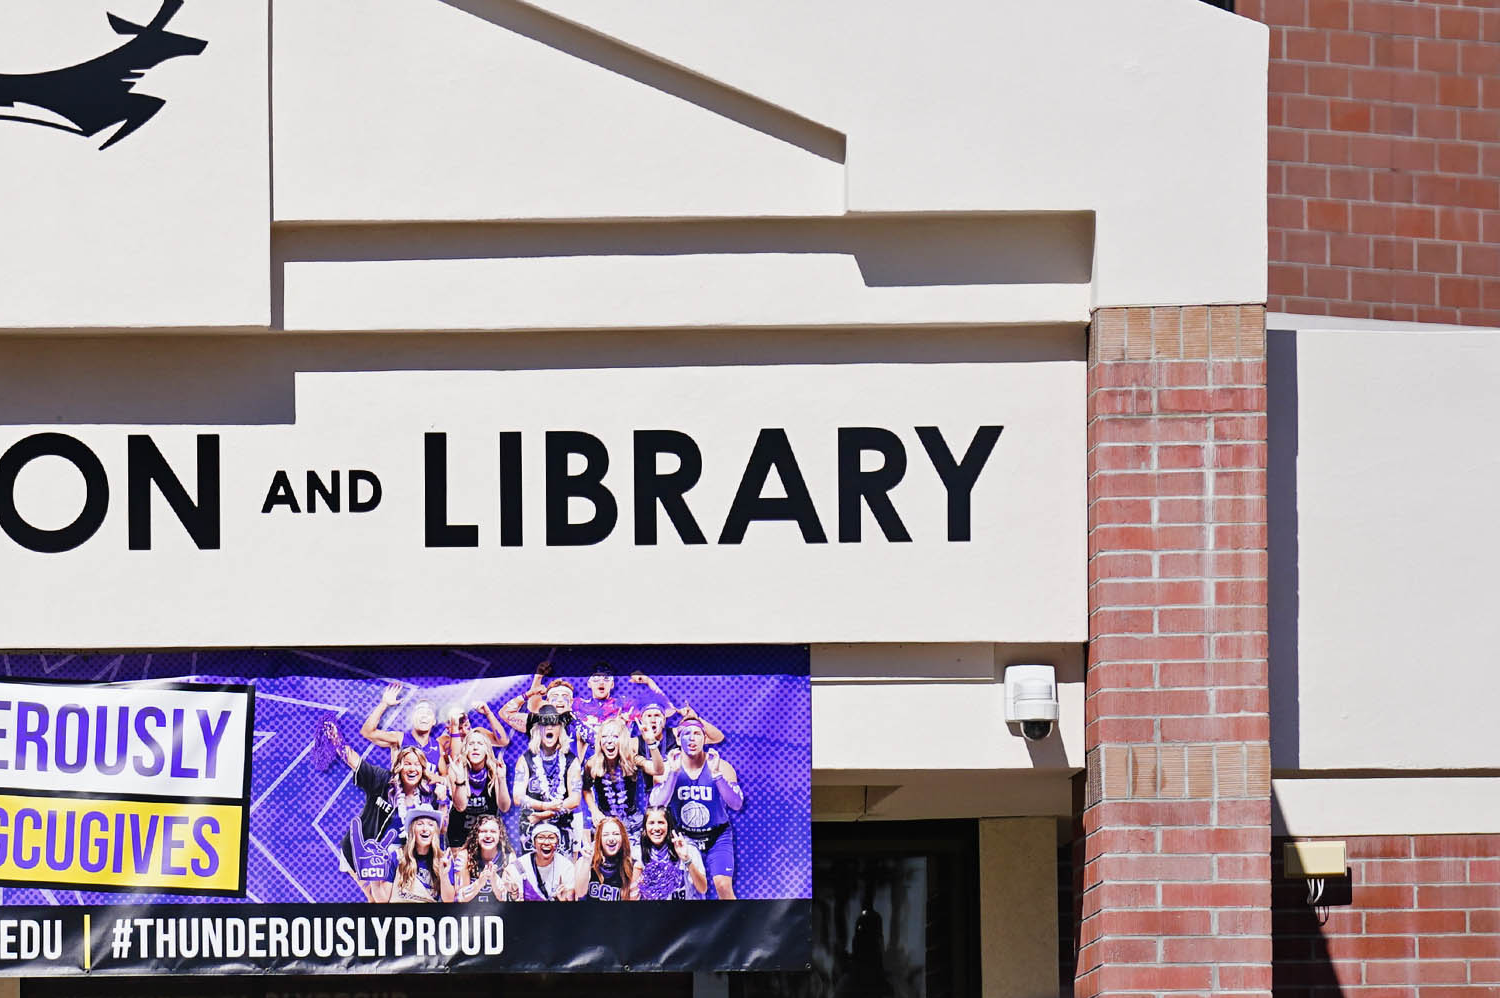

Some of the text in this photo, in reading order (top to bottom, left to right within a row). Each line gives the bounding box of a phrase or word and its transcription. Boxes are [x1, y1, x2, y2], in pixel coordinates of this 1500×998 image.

[261, 470, 383, 514] AND
[424, 425, 1004, 548] LIBRARY
[677, 785, 713, 801] GCU
[361, 867, 385, 878] GCU
[111, 915, 505, 959] #THUNDEROUSLYPROUD
